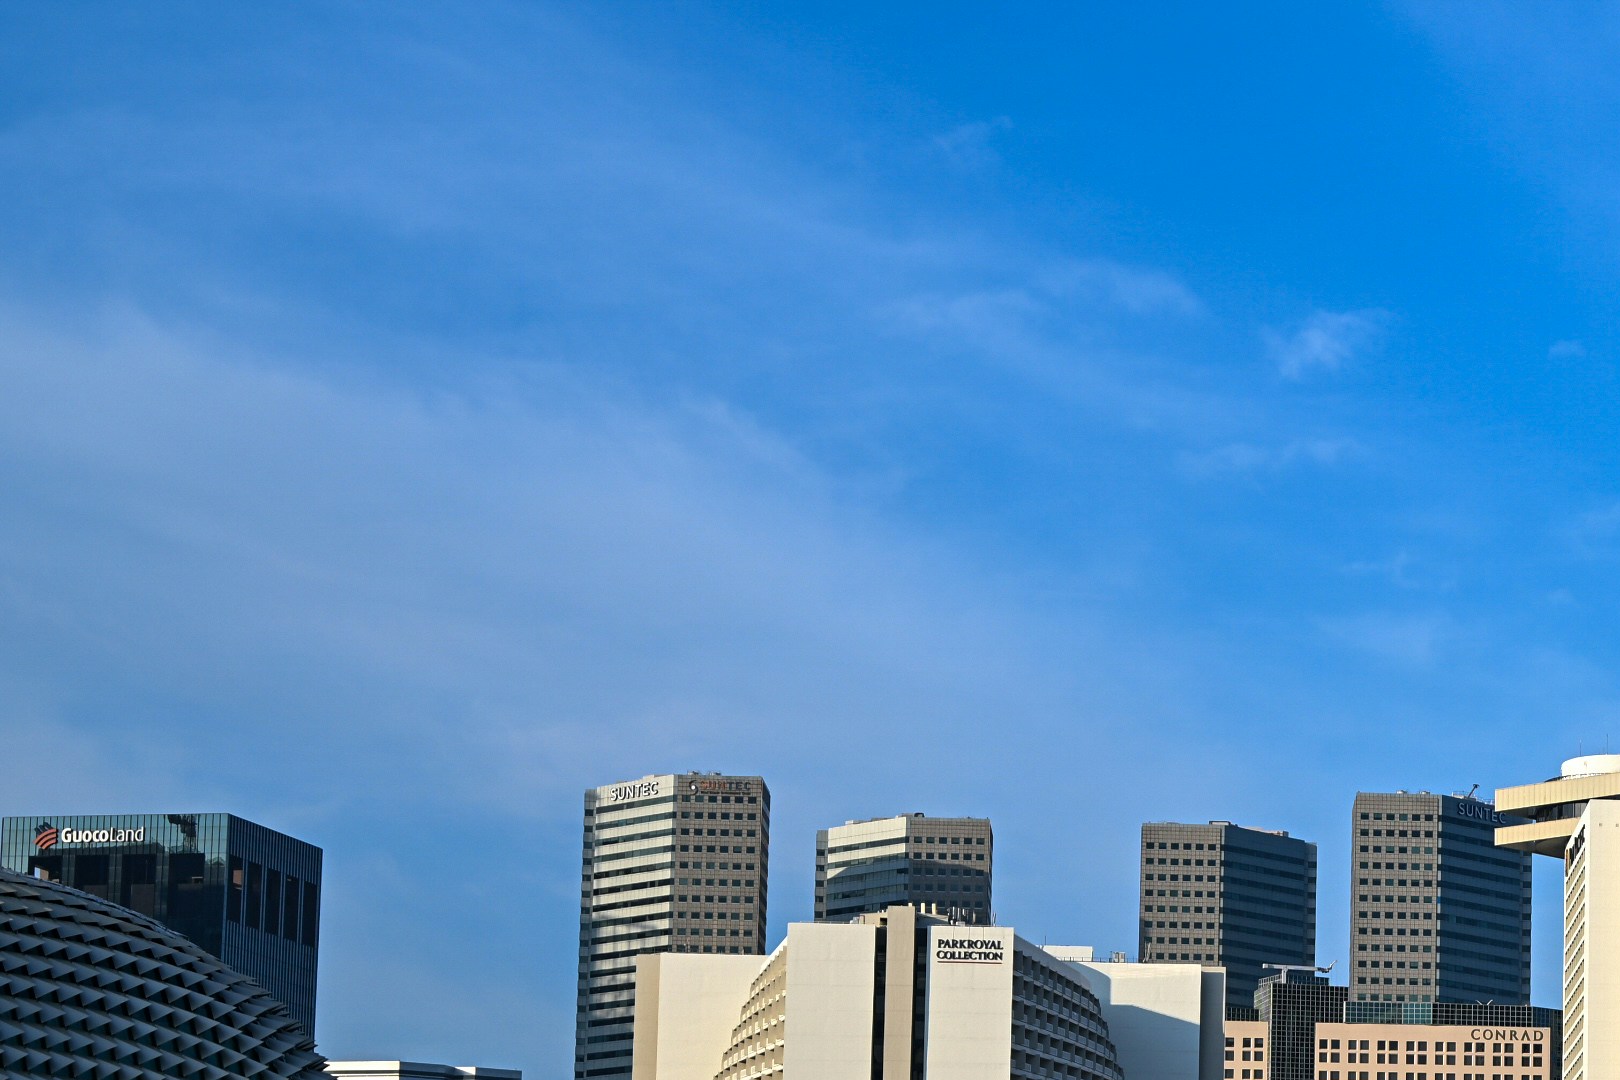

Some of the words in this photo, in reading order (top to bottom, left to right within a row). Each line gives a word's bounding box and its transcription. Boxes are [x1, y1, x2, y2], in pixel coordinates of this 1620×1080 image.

[610, 781, 659, 801] SUNTEC
[1458, 802, 1507, 824] SUNTEC
[61, 826, 144, 843] GuocoLand
[937, 939, 1004, 950] PARKROYAL
[936, 950, 1003, 960] COLLECTION
[1470, 1029, 1544, 1041] CONRAD
